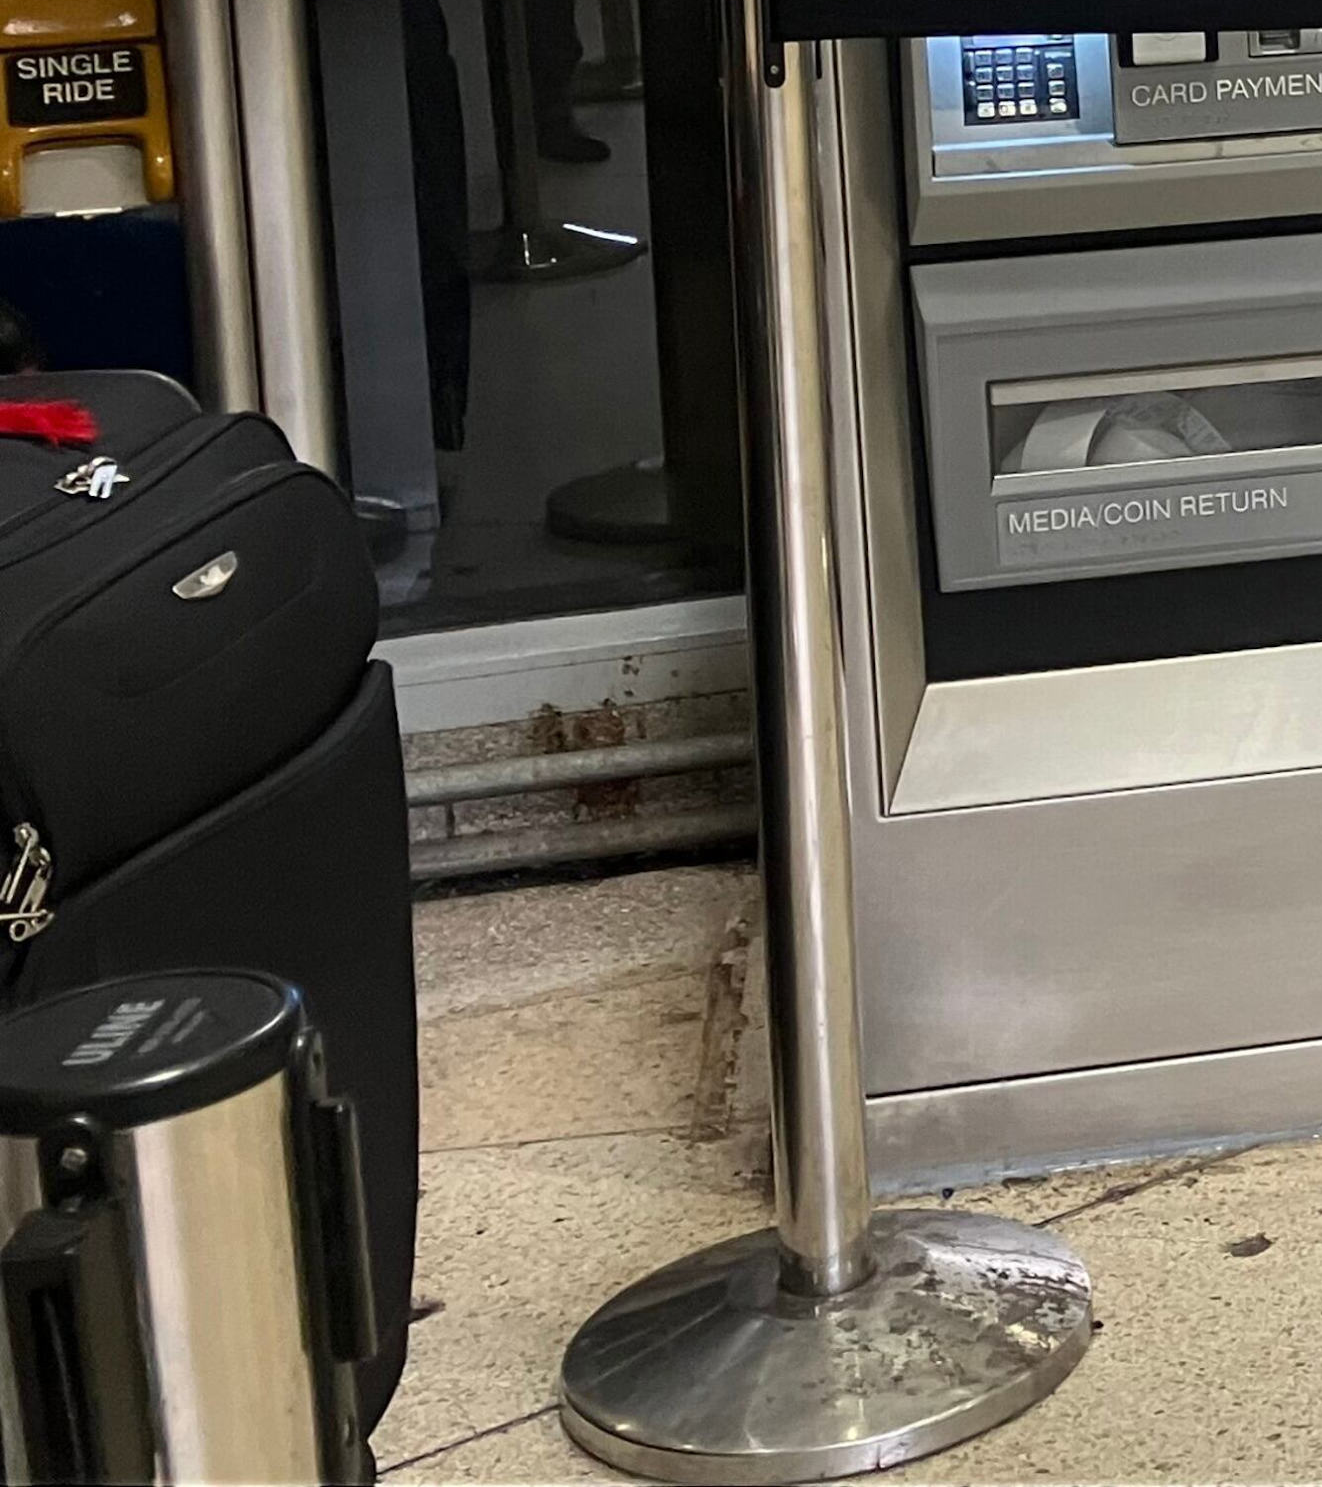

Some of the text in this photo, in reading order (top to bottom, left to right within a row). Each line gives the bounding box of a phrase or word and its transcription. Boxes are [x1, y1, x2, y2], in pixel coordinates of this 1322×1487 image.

[17, 51, 132, 79] SINGLE
[43, 79, 114, 104] RIDE
[1130, 82, 1207, 106] CARD
[1009, 488, 1287, 535] MEDIA/COIN RETURN
